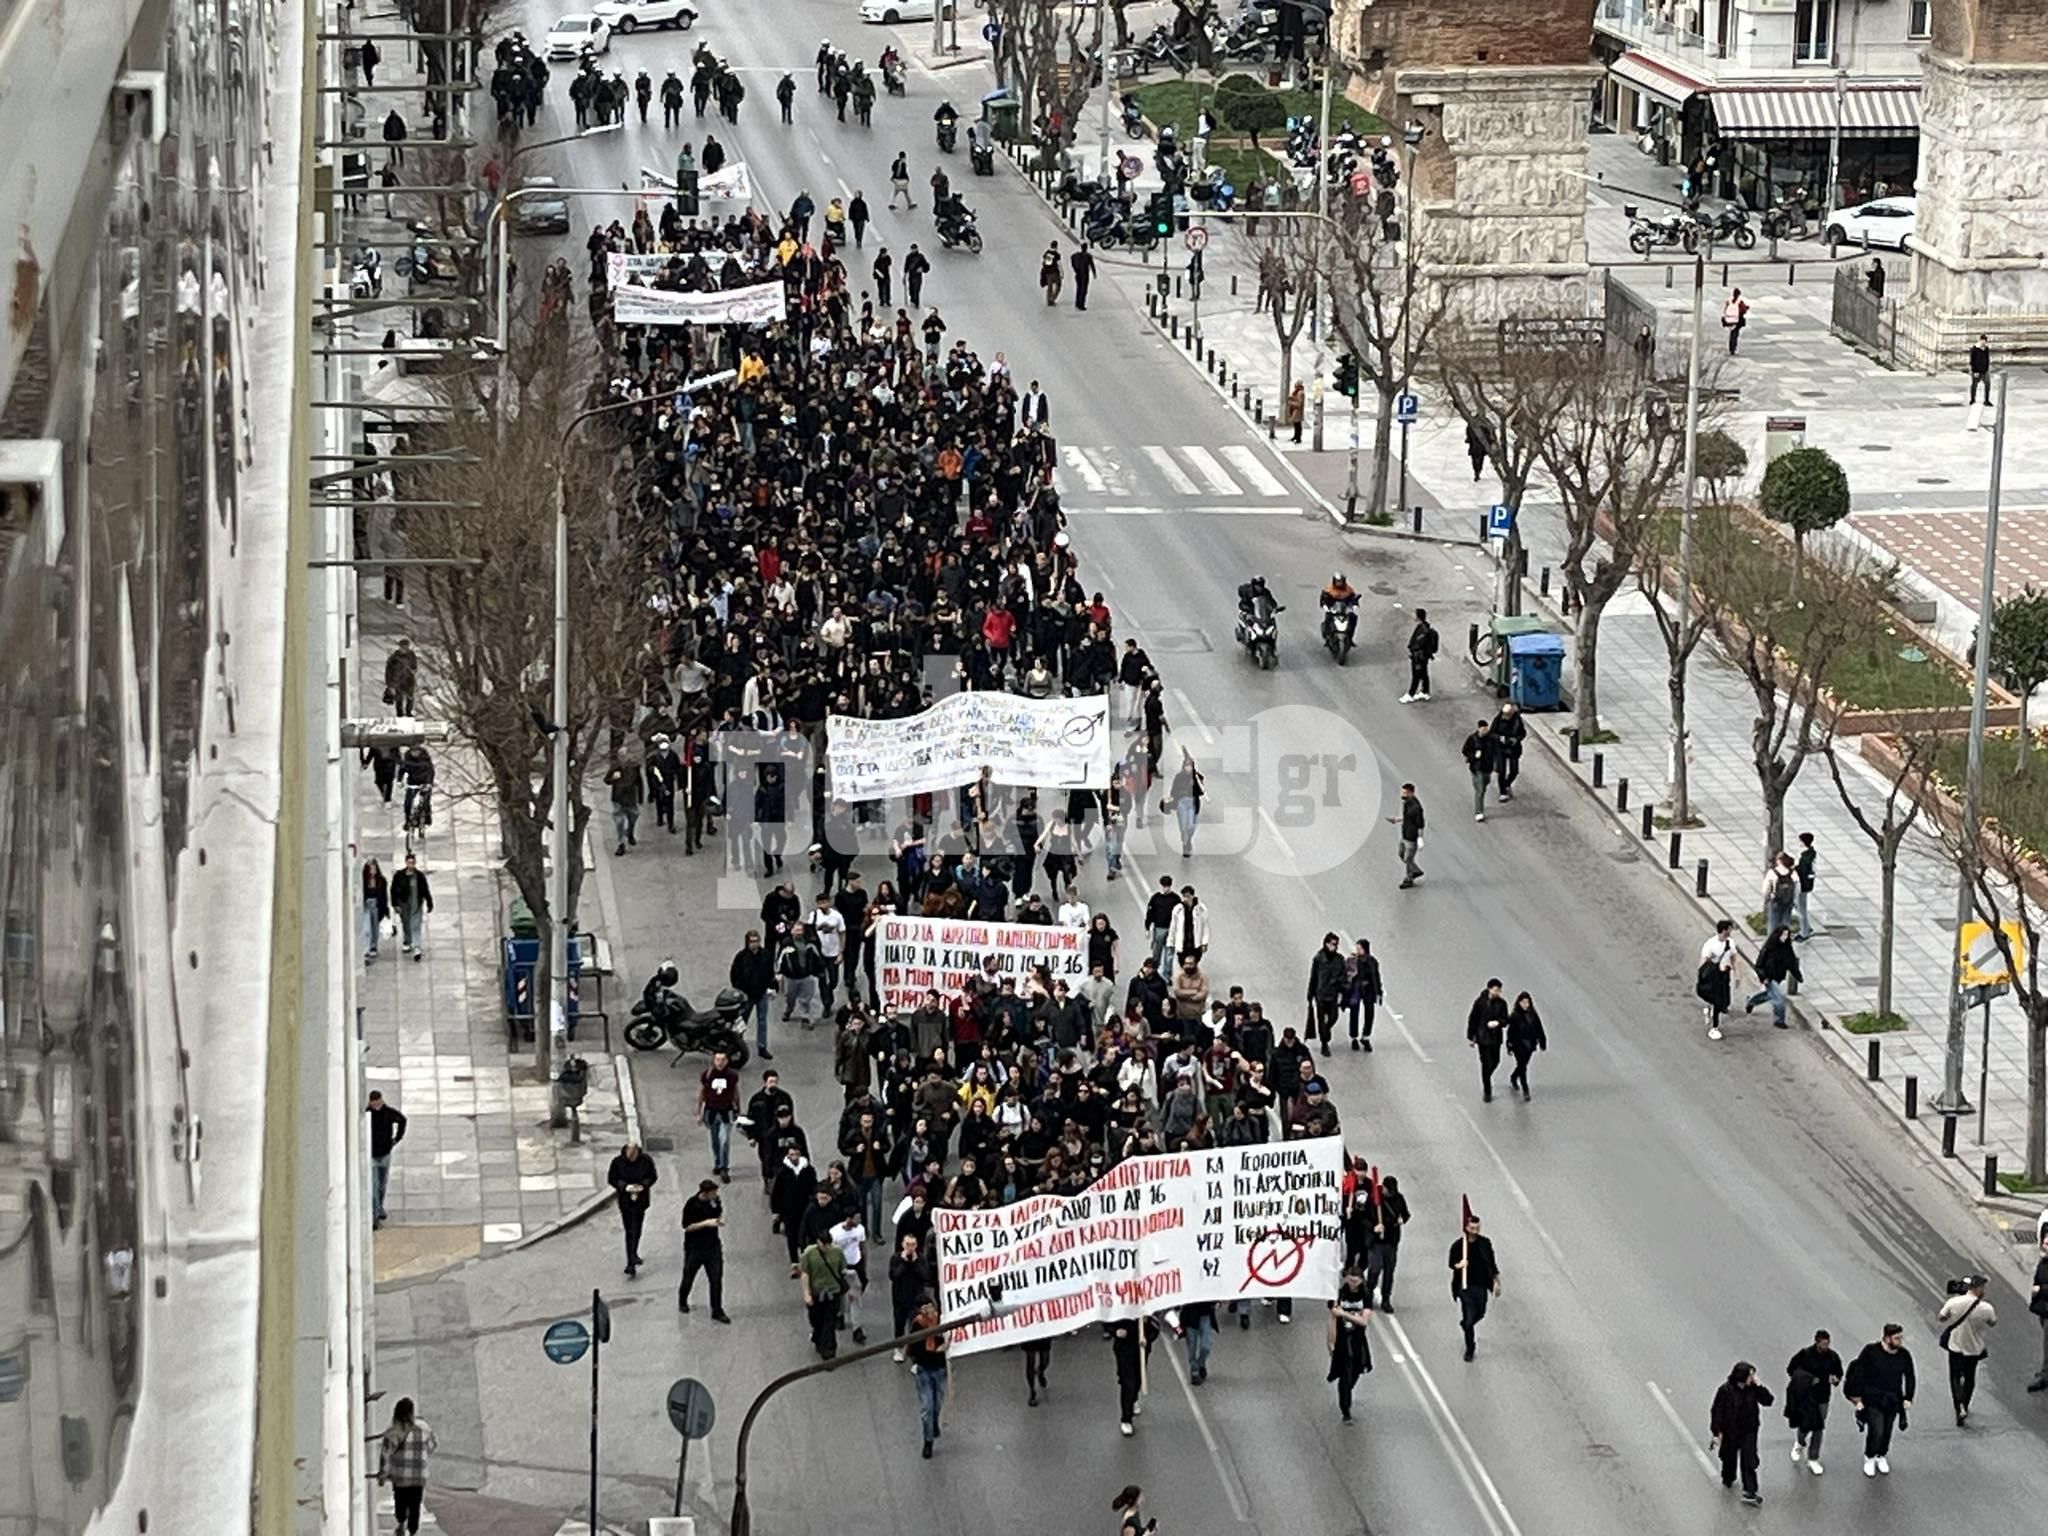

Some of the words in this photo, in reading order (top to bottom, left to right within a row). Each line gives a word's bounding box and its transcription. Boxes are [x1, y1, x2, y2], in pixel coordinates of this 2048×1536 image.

[1402, 397, 1414, 414] P
[1494, 506, 1508, 526] P
[856, 761, 880, 777] ΣΤΑ
[922, 946, 937, 967] ΤΑ
[941, 949, 982, 970] ΧΕΡΙΑ
[1063, 953, 1084, 974] 16
[1206, 1156, 1224, 1174] ΚΑ
[1206, 1180, 1223, 1200] ΤΑ
[940, 1212, 967, 1233] ΟΧΙ
[971, 1213, 1002, 1229] ΣΤΑ
[942, 1231, 984, 1257] ΚΑΤΩ
[991, 1229, 1009, 1249] ΤΑ
[1061, 1195, 1091, 1222] ΑΠΟ
[1099, 1193, 1117, 1215] ΤΟ
[1149, 1183, 1167, 1206] 16
